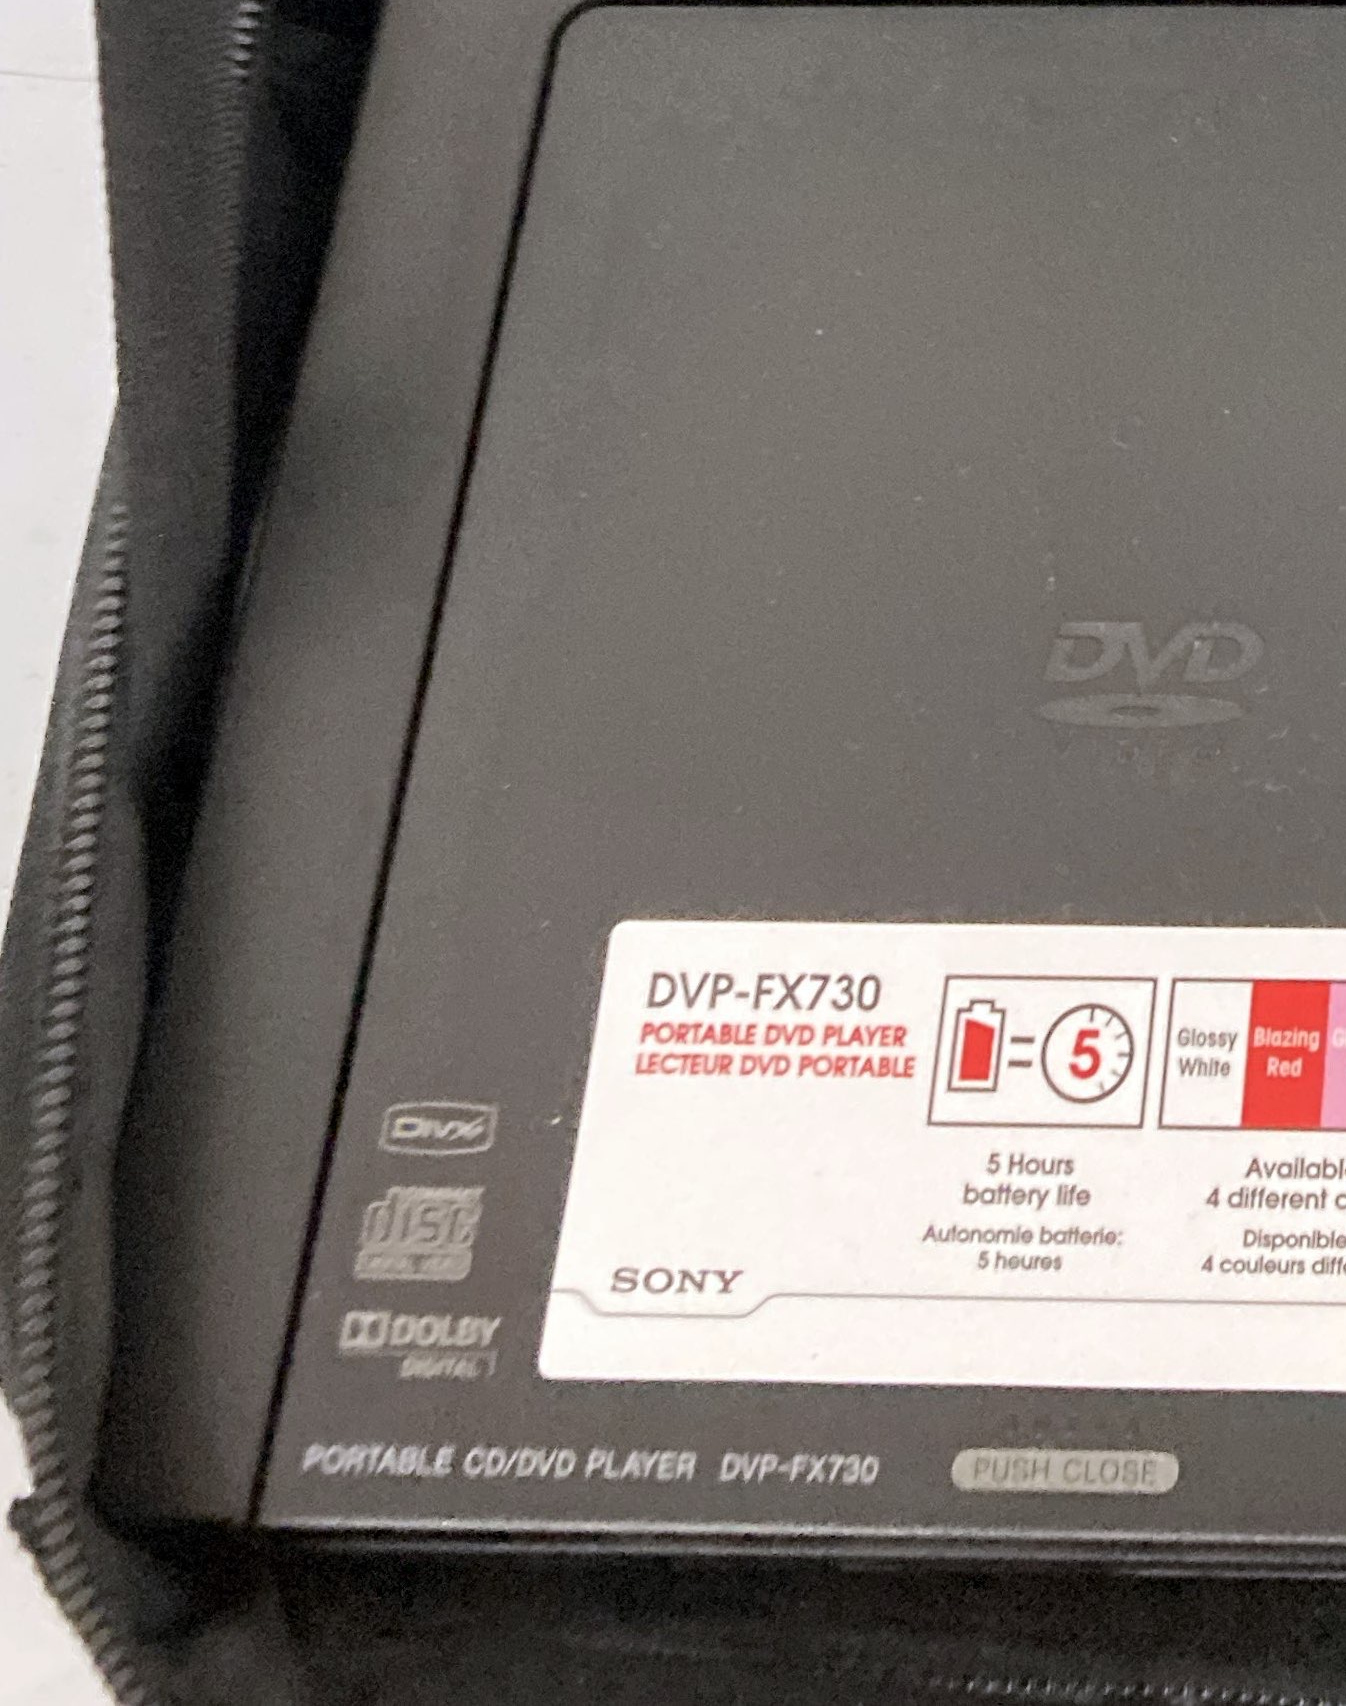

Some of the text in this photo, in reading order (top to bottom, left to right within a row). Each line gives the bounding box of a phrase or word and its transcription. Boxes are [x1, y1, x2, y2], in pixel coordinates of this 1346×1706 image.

[1042, 620, 1265, 696] DVD
[647, 971, 881, 1012] DVP-FX730
[640, 1023, 907, 1048] PORTABLE DVD PLAYER
[1177, 1027, 1238, 1050] Glossy
[1254, 1026, 1321, 1052] Blazing
[635, 1053, 916, 1079] LECTEUR DVD PORTABLE
[1067, 1027, 1102, 1080] 5
[1179, 1057, 1231, 1077] White
[1266, 1057, 1303, 1078] Red
[986, 1153, 1075, 1177] 5 Hours
[963, 1183, 1092, 1211] battery life
[1205, 1188, 1221, 1210] 4
[1227, 1187, 1330, 1211] different
[921, 1224, 1124, 1247] Autonomie batterie:
[1242, 1230, 1346, 1256] Disponible
[977, 1251, 1063, 1272] 5 heures
[1201, 1257, 1214, 1276] 4
[1219, 1257, 1307, 1277] couleurs
[609, 1267, 744, 1294] SONY
[390, 1312, 501, 1348] DOLBY
[302, 1444, 880, 1485] PORTABLE CD/DVD PLAYER DVP-FX730
[973, 1456, 1158, 1486] PUSH CLOSE
